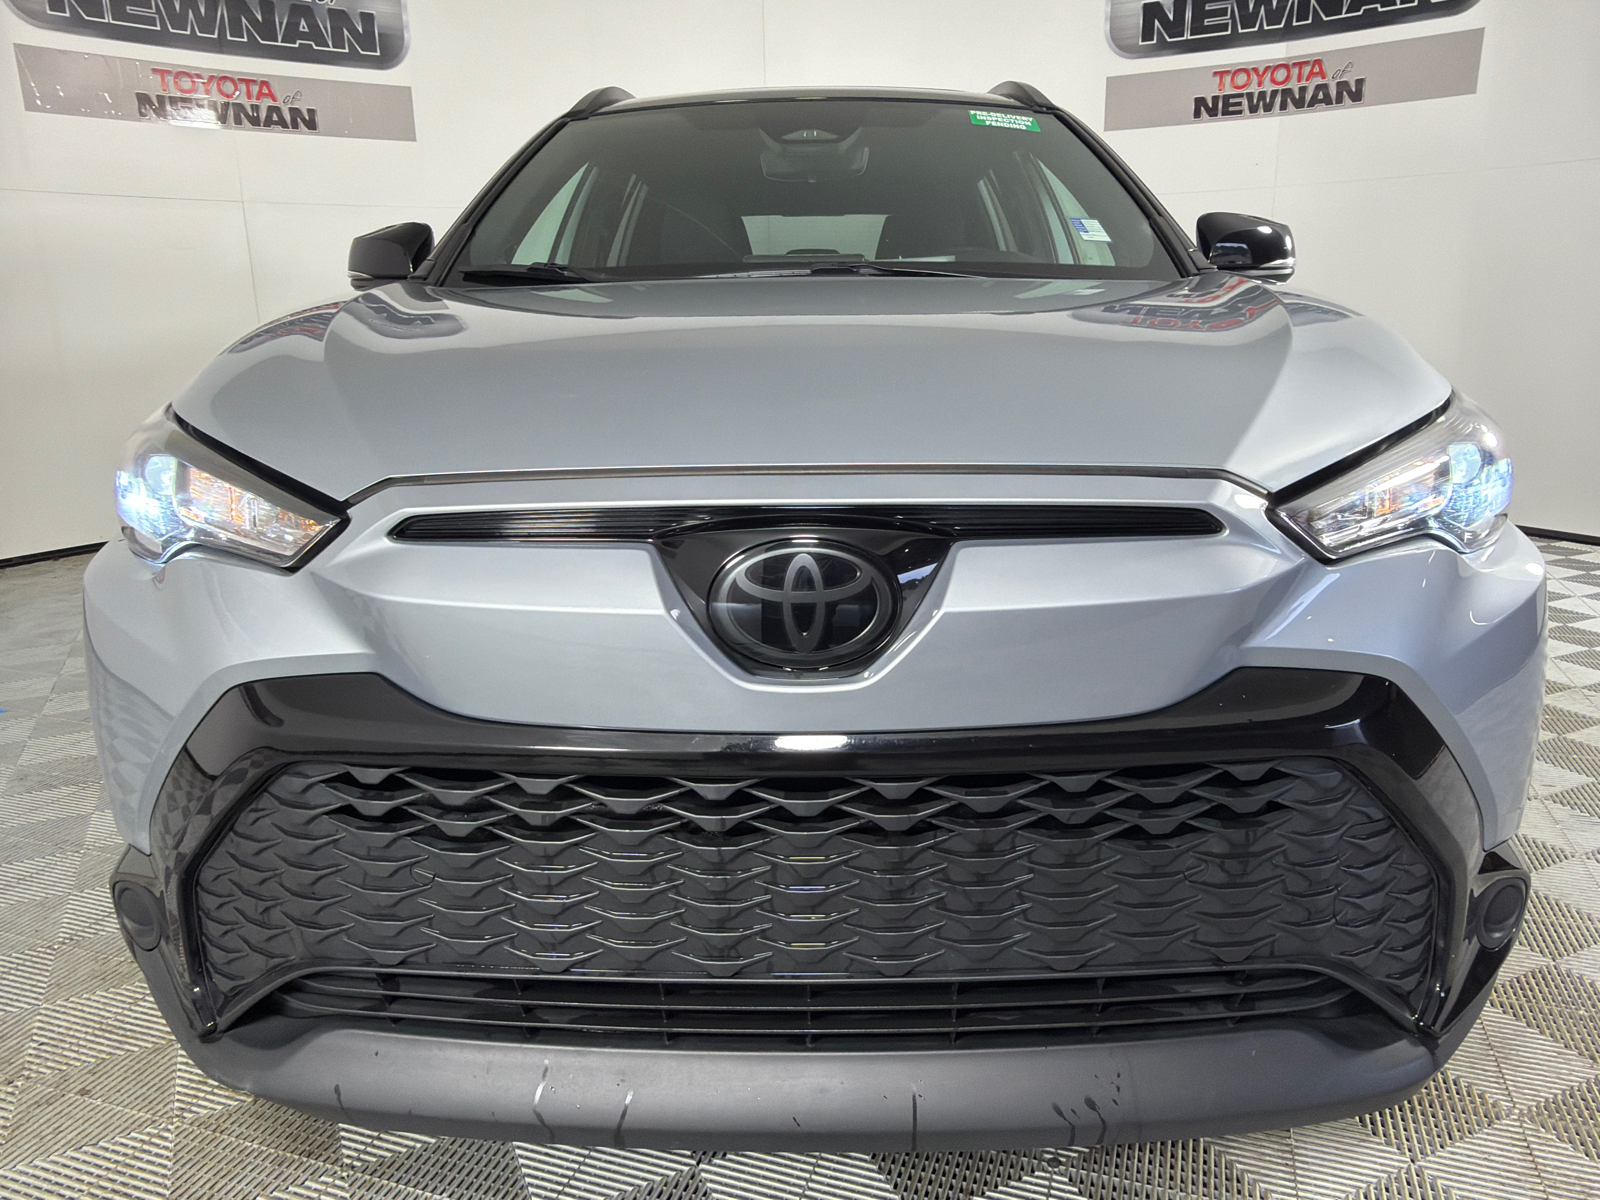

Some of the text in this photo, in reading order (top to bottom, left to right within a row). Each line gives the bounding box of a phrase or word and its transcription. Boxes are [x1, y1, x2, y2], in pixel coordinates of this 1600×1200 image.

[1139, 0, 1451, 45] NEW
[151, 67, 303, 106] TOYOTA of
[1213, 57, 1353, 92] TOYOTA of
[969, 109, 1034, 122] PRE-DELIVERY
[1192, 77, 1366, 120] NEWNAN
[976, 115, 1033, 126] INSPECTION
[985, 120, 1027, 131] PENDING
